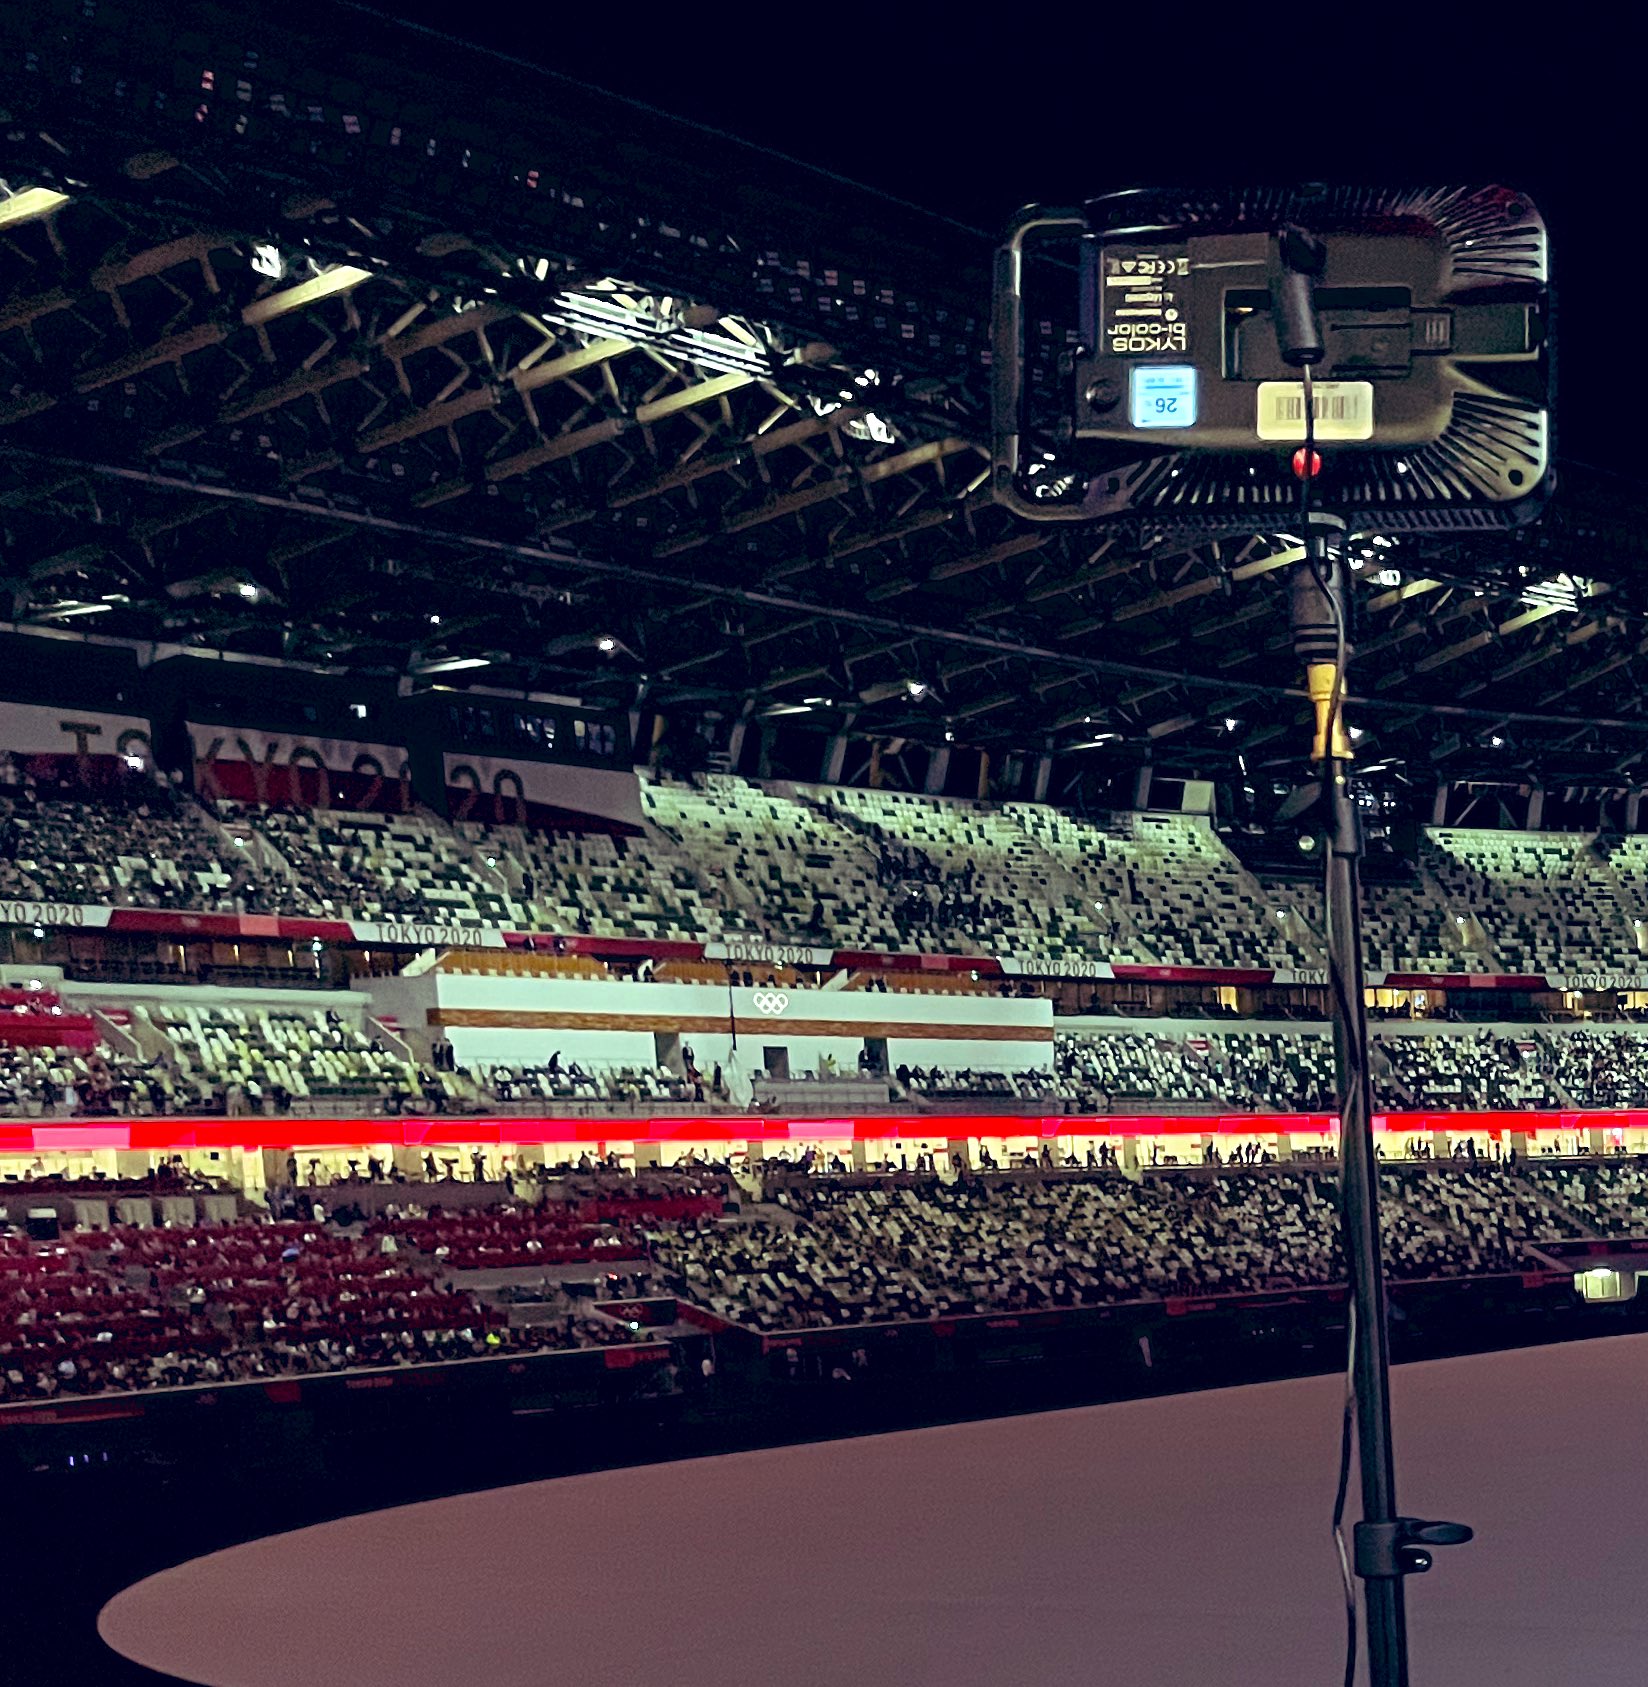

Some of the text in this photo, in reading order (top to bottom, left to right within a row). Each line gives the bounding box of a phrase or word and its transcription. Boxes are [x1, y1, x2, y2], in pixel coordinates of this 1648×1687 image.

[1107, 323, 1187, 338] bi-color
[1112, 336, 1187, 352] LYKOS
[1155, 397, 1178, 414] 26
[32, 904, 84, 927] 2020
[376, 922, 483, 947] TOKYO 2020
[726, 942, 814, 965] TOKYO 2020
[1018, 960, 1097, 978] TOKYO 2020
[1292, 969, 1329, 985] TOKY
[1564, 975, 1642, 989] TOKYO 2020
